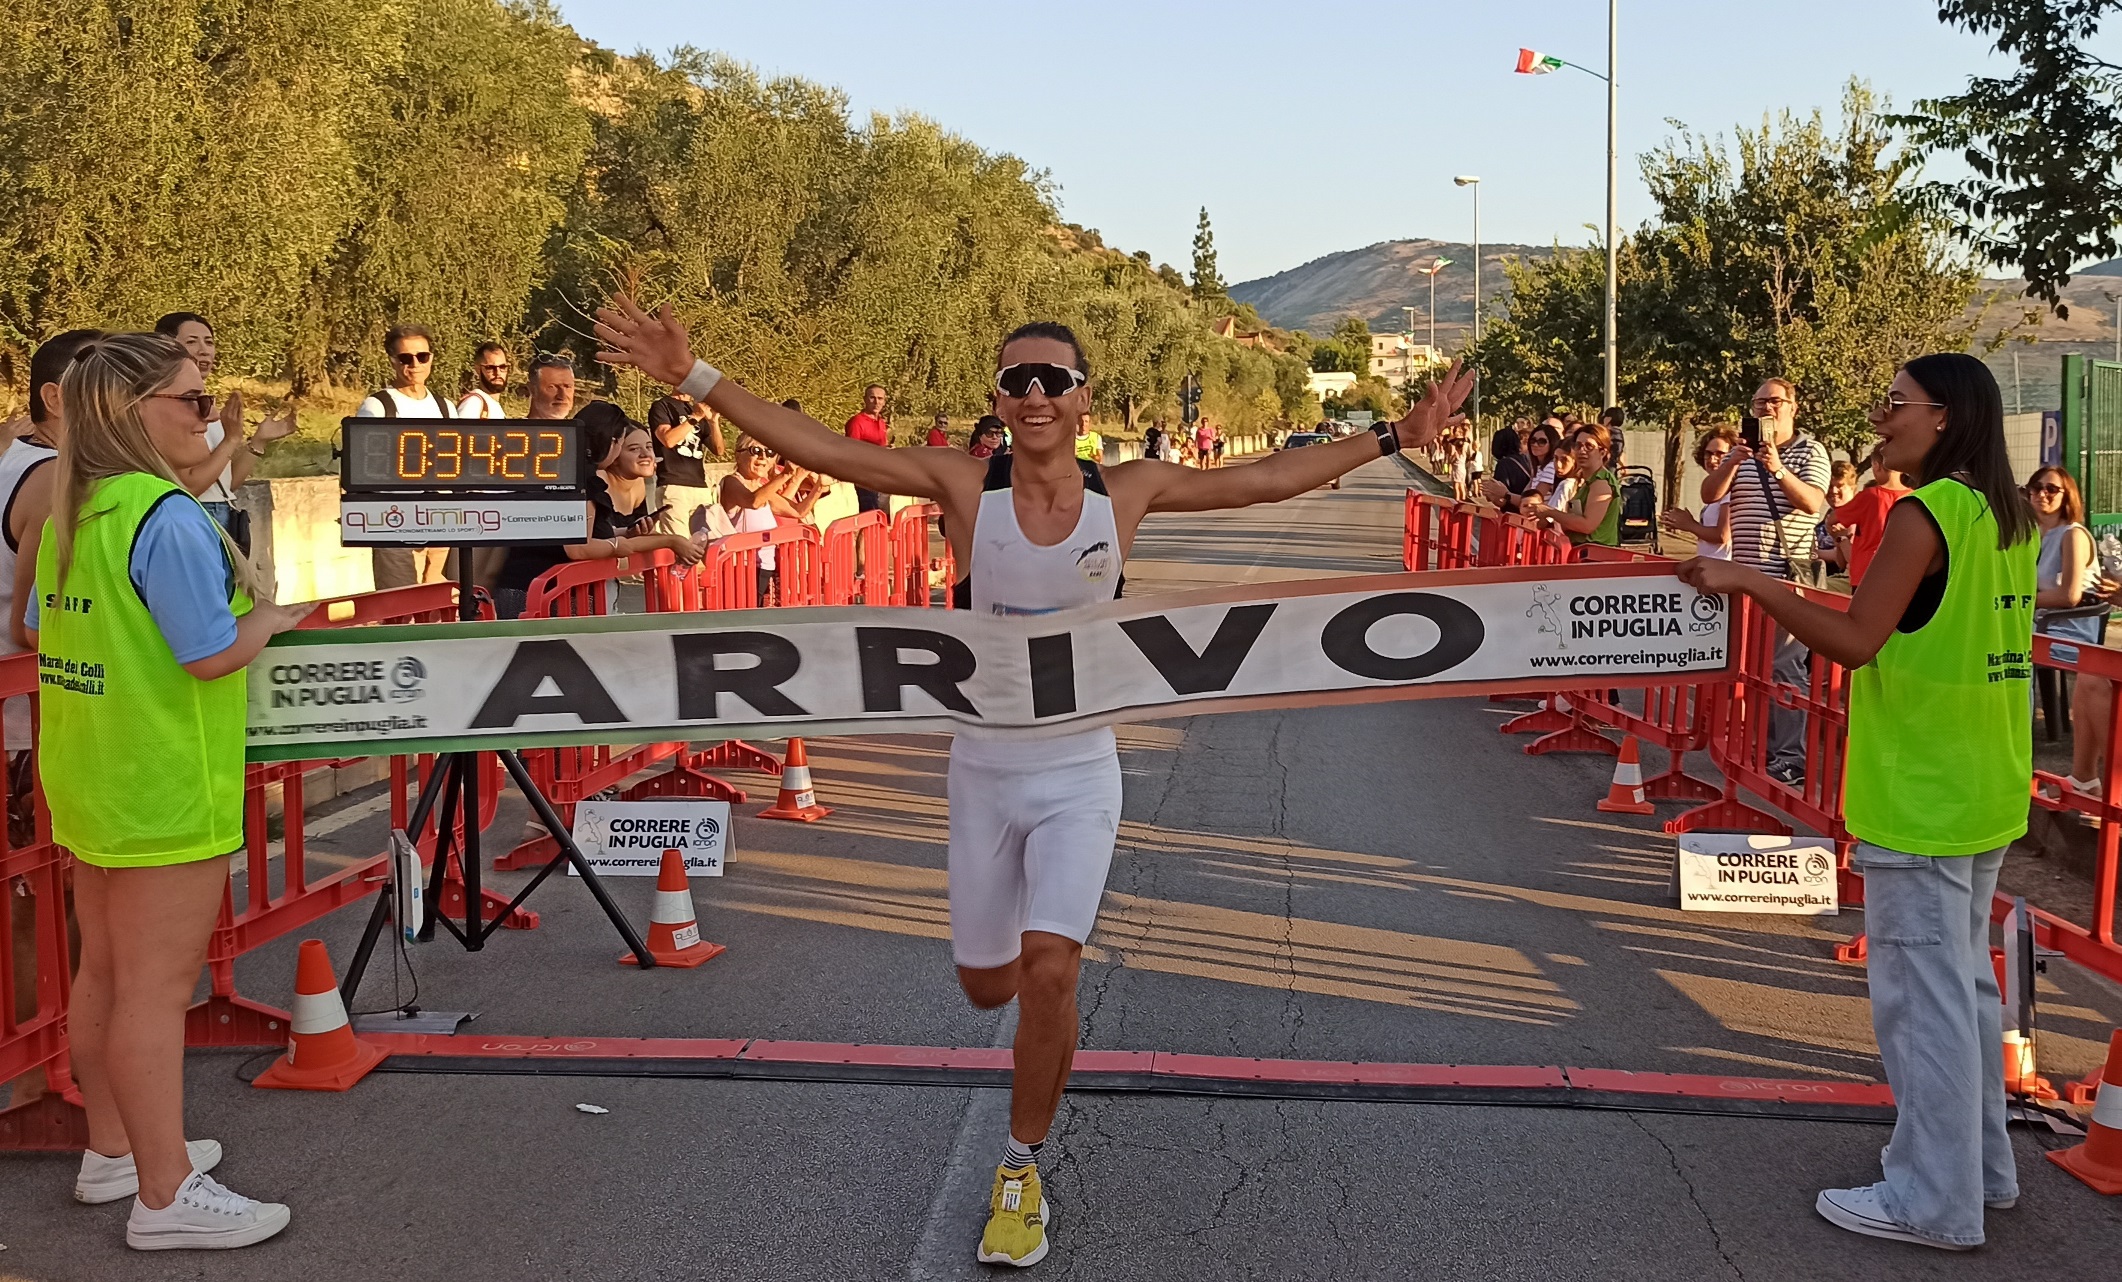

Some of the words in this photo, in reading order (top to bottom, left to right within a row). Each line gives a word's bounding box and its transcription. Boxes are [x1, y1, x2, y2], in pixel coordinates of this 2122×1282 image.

[2043, 417, 2058, 463] P
[398, 431, 563, 479] 0:34:22
[415, 504, 501, 531] timing
[1569, 593, 1683, 616] CORRERE
[1571, 620, 1594, 639] IN
[1600, 617, 1683, 638] PUGLIA
[467, 591, 1486, 729] ARRIVO
[1530, 647, 1724, 668] www.correreinpuglia.it
[80, 662, 105, 678] Colli
[271, 660, 386, 684] CORRERE
[271, 689, 294, 708] IN
[299, 685, 386, 706] PUGLIA
[609, 819, 691, 833] CORRERE
[608, 835, 626, 848] IN
[628, 835, 689, 849] PUGLIA
[1717, 853, 1799, 868] CORRERE
[1718, 870, 1735, 882] IN
[1739, 870, 1800, 885] PUGLIA
[1688, 893, 1832, 907] www.correreinpuglia.it
